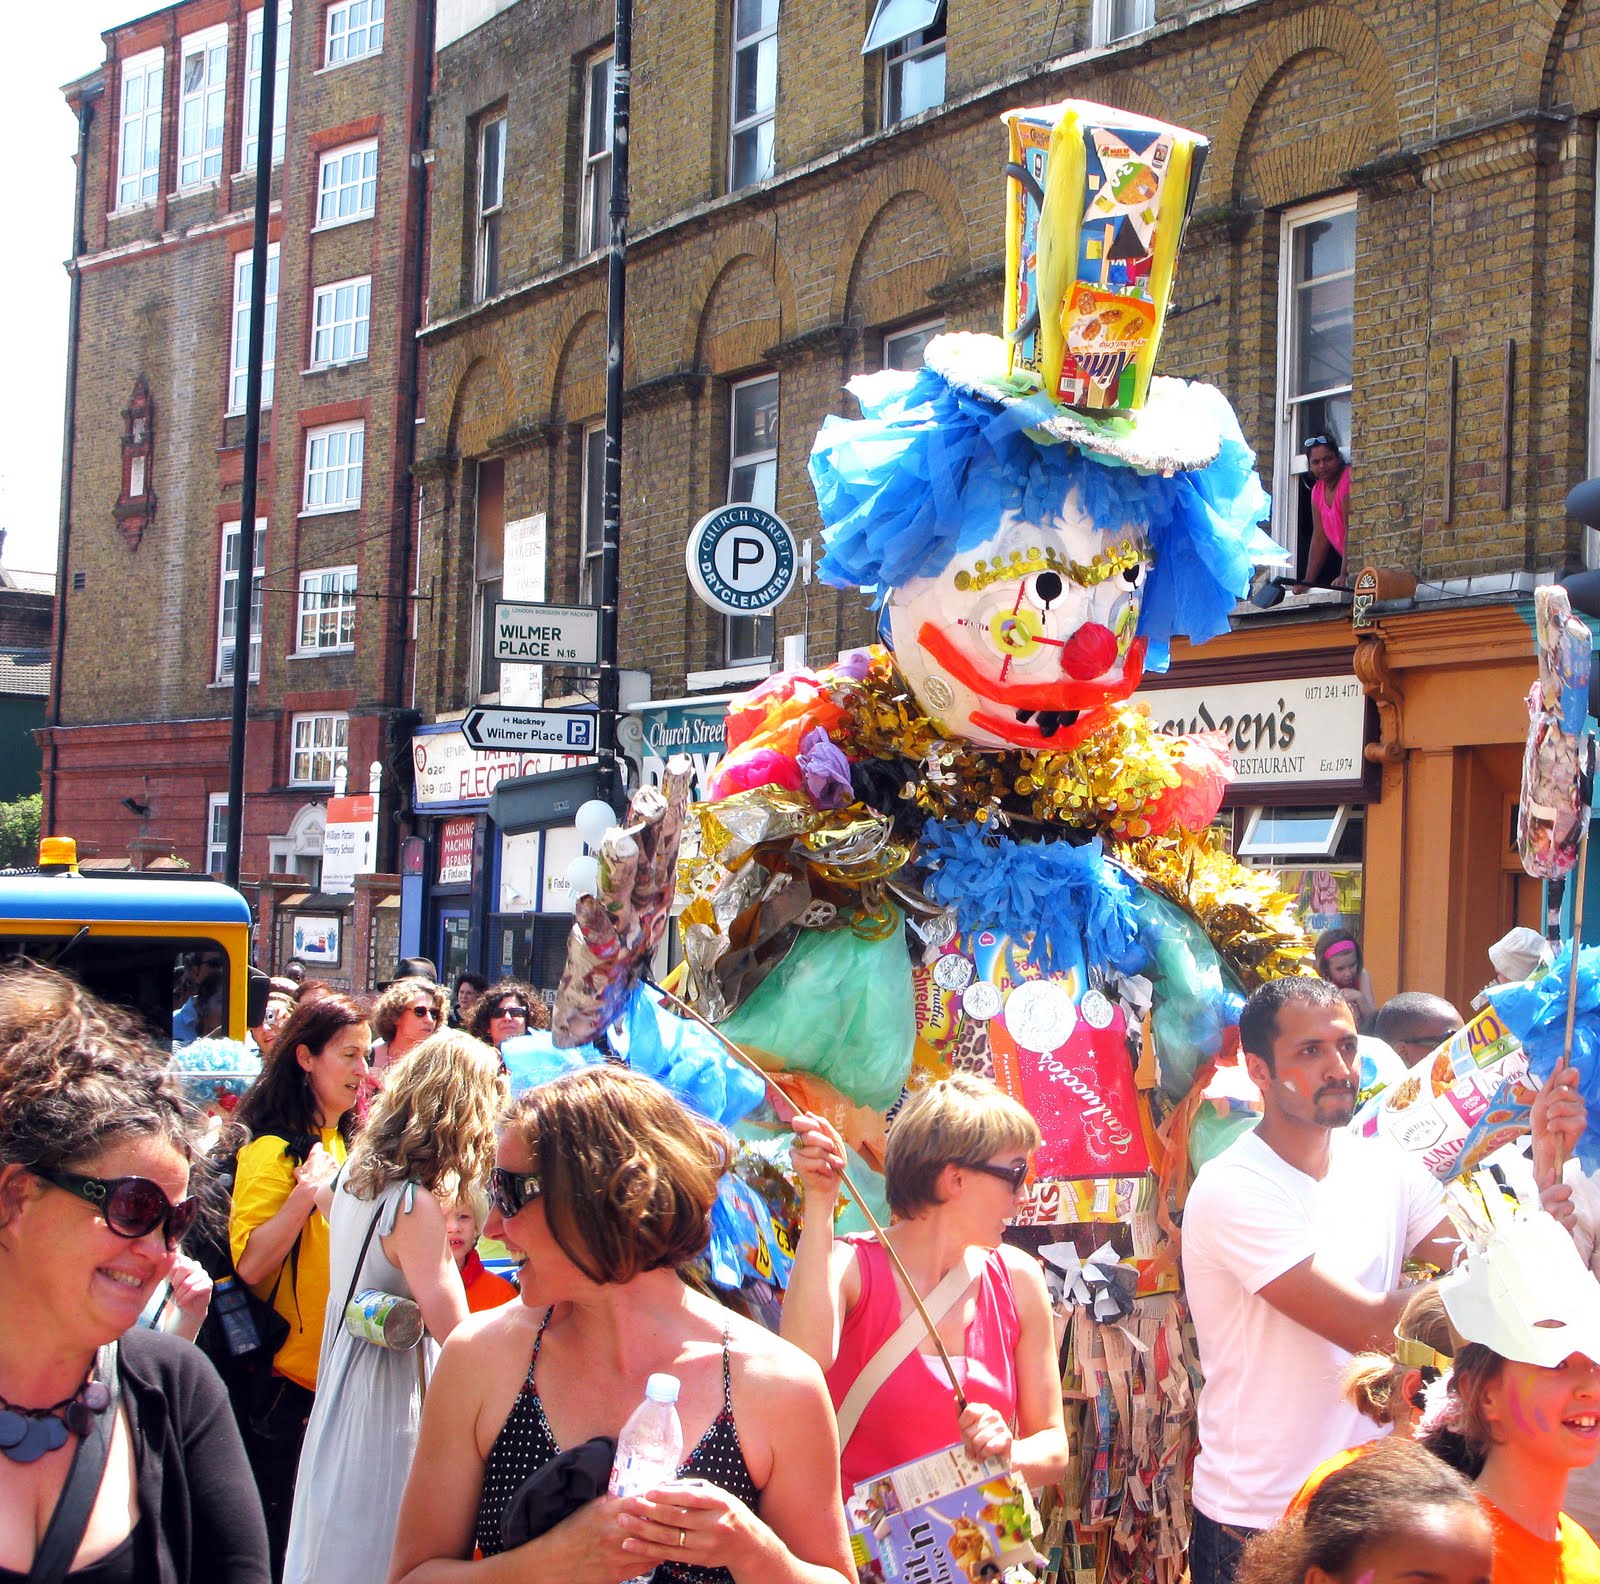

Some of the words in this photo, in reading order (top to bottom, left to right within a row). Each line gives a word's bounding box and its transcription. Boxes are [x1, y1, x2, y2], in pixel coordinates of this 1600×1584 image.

[701, 510, 748, 551] CHURCH
[752, 512, 790, 557] STREET
[732, 537, 764, 580] P
[701, 561, 789, 607] DRYCLEANERS
[500, 624, 561, 641] WILMER
[499, 641, 550, 657] PLACE
[557, 649, 576, 658] N.16
[1305, 686, 1321, 700] 0171
[1324, 685, 1339, 699] 241
[1341, 684, 1359, 698] 4171
[512, 717, 545, 726] Hackney
[487, 728, 528, 740] Wilmer
[531, 730, 563, 741] Place
[571, 722, 586, 743] P
[650, 720, 690, 747] Church
[692, 718, 727, 744] Street
[1233, 756, 1305, 775] RESTAURANT
[1320, 759, 1333, 772] Est.
[1335, 758, 1353, 771] 1974
[445, 822, 474, 837] WASHING
[1003, 1054, 1014, 1099] PANETTON
[1038, 1051, 1133, 1155] Carluccio's
